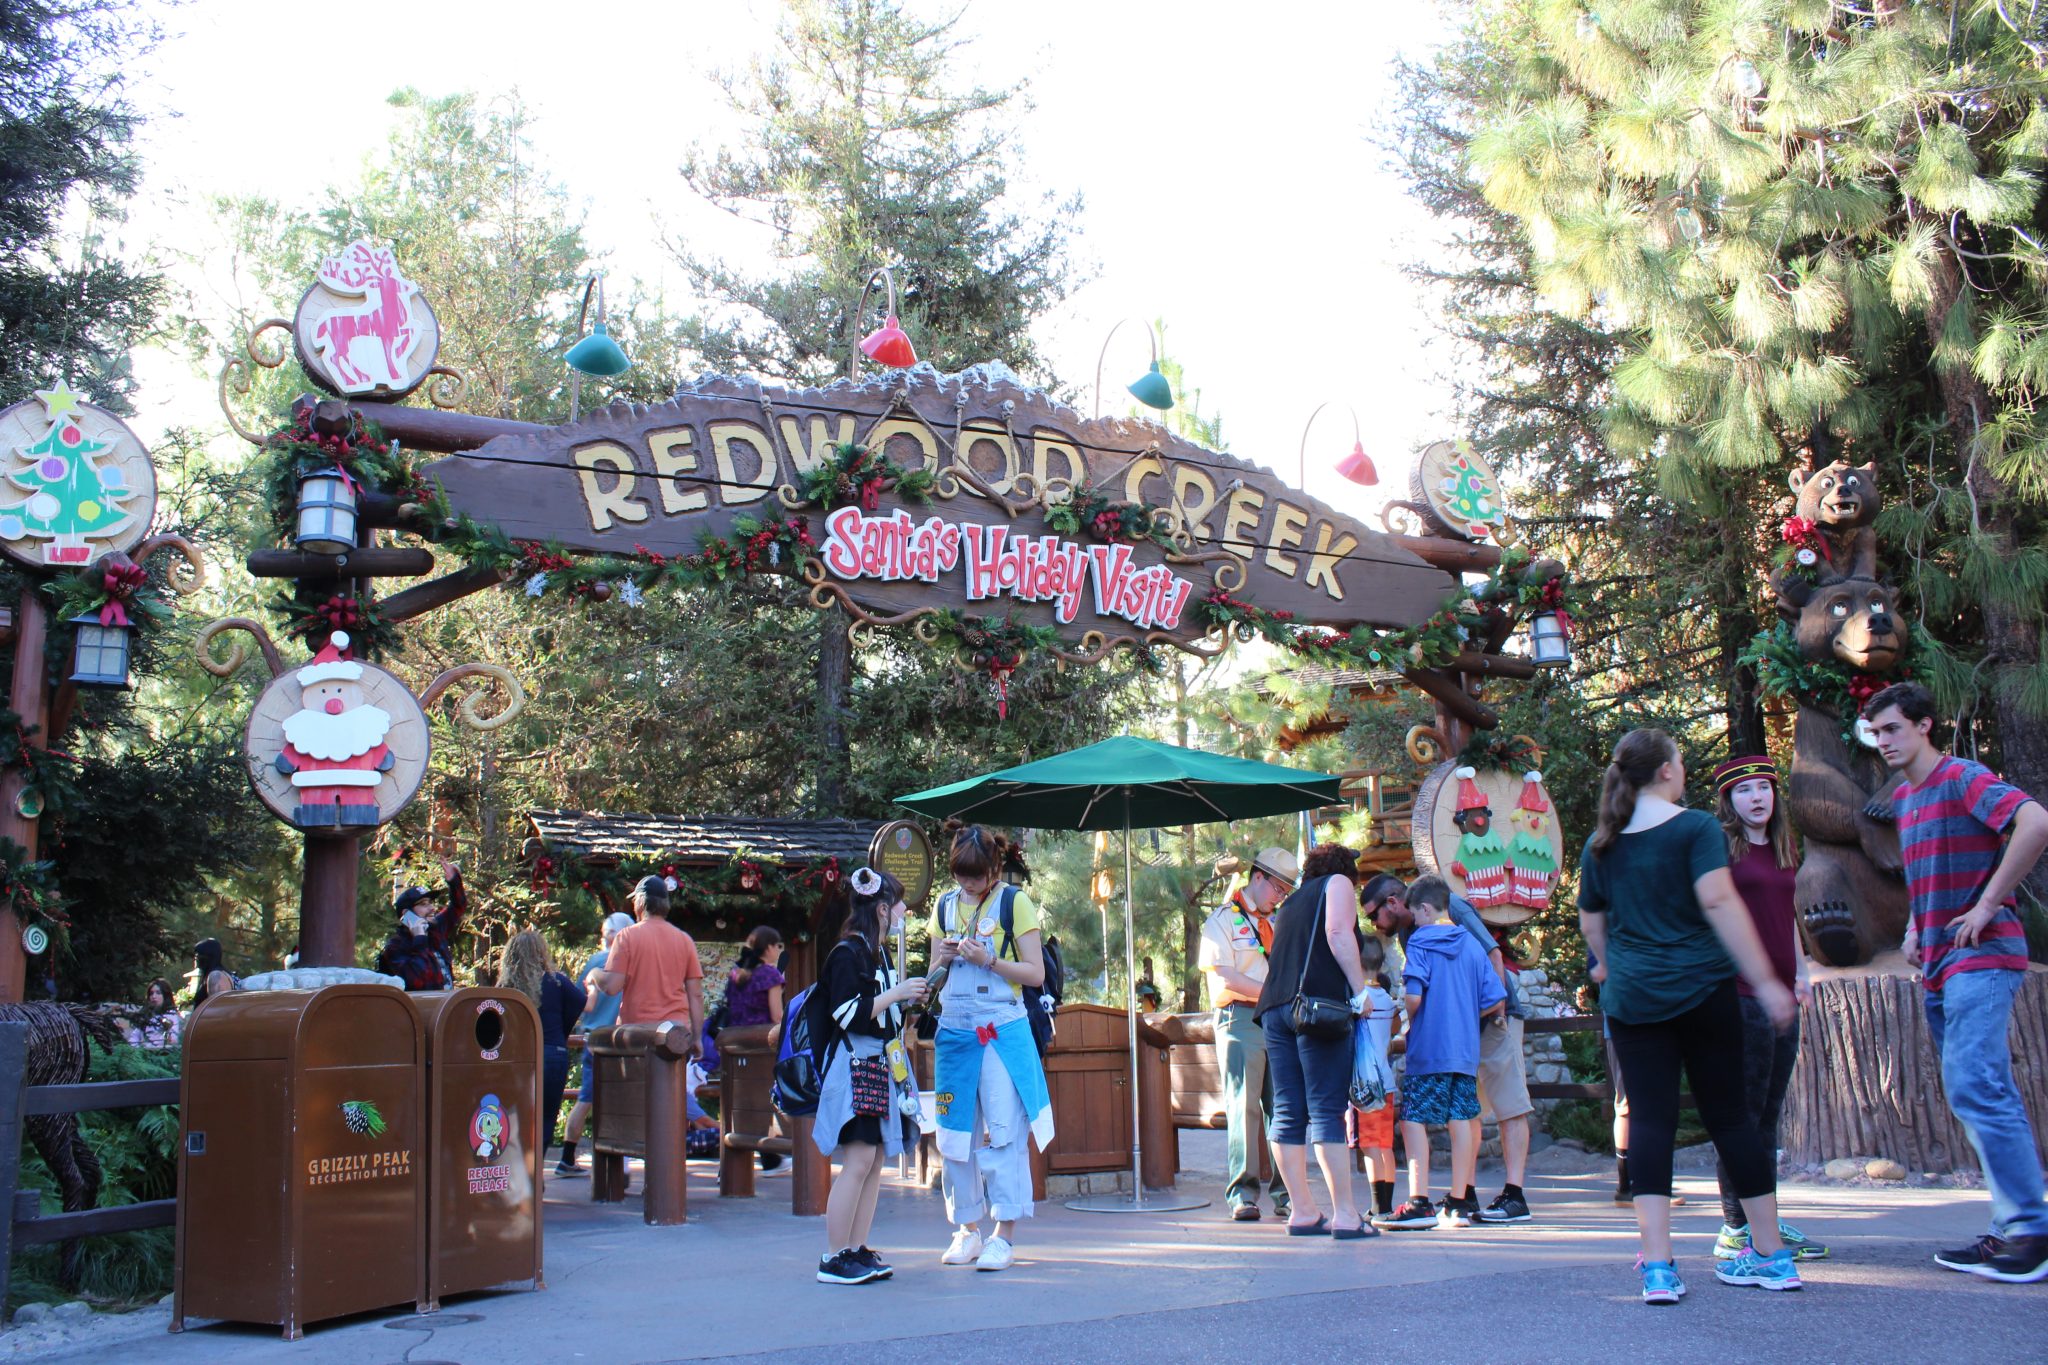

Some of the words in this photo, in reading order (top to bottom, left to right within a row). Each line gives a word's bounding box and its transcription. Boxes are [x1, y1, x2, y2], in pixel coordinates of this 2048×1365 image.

[574, 415, 1086, 532] REDWOOD
[1125, 458, 1360, 600] CREEK
[820, 506, 961, 582] Santa's
[961, 522, 1090, 625] Holiday
[1087, 543, 1193, 631] Visit!
[308, 1154, 368, 1175] GRIZZLY
[373, 1150, 410, 1168] PEAK
[468, 1165, 510, 1180] RECYCLE
[309, 1169, 378, 1185] RECREATION
[383, 1166, 410, 1176] AREA
[470, 1178, 508, 1194] PLEASE
